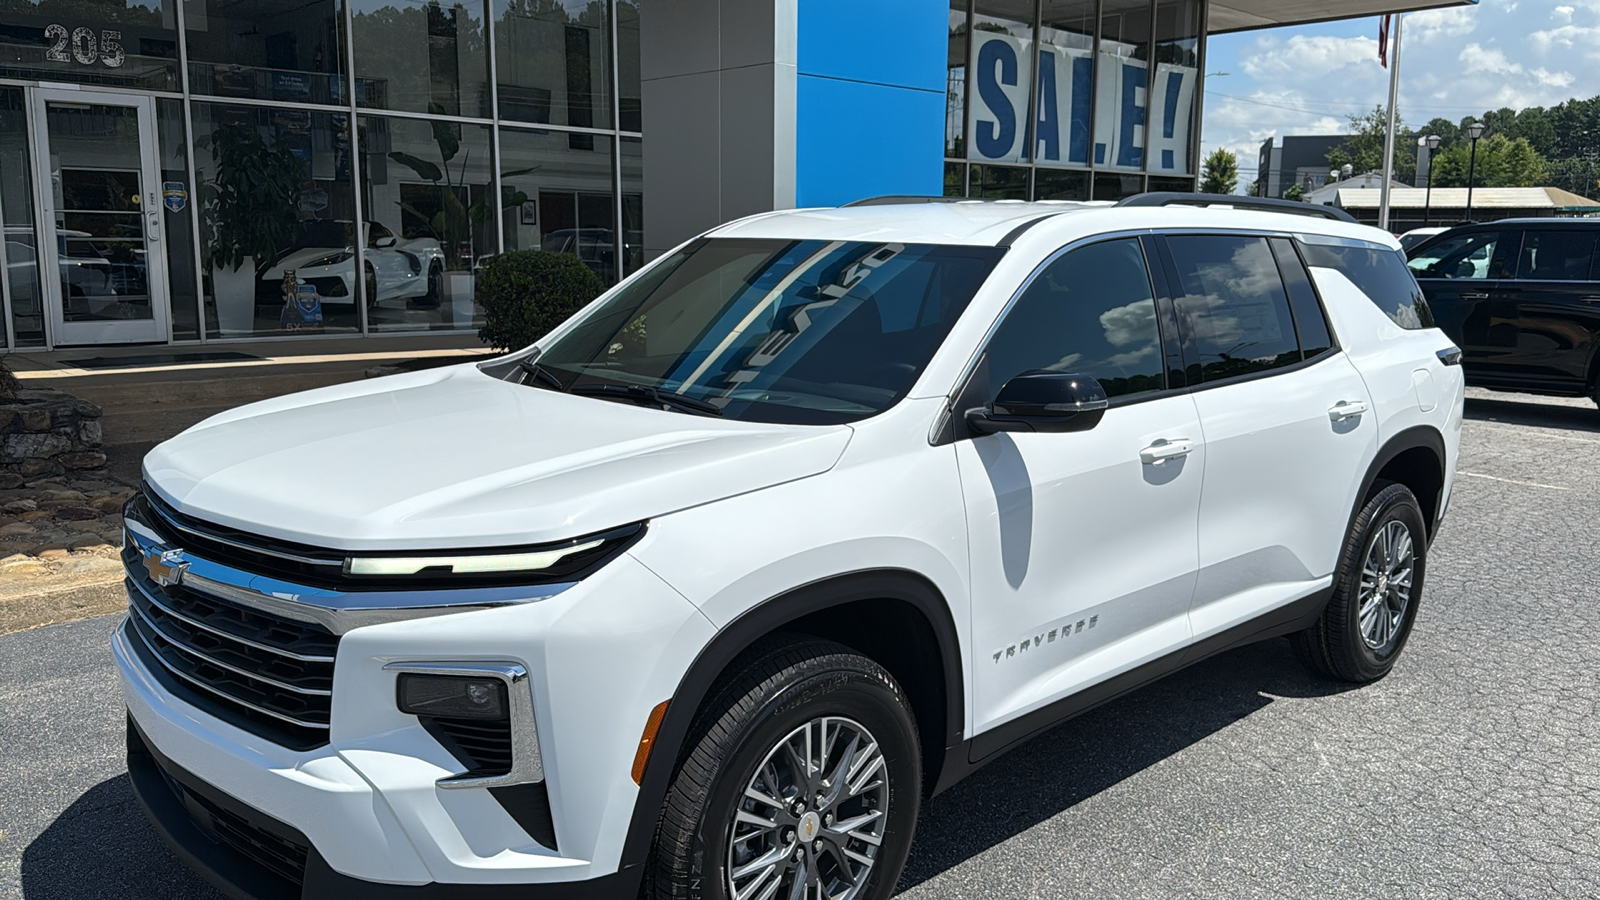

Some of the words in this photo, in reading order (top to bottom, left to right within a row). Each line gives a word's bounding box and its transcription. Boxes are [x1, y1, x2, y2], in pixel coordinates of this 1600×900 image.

[44, 23, 125, 68] 205
[975, 38, 1184, 170] SALE!
[992, 613, 1100, 664] TRAVERSE
